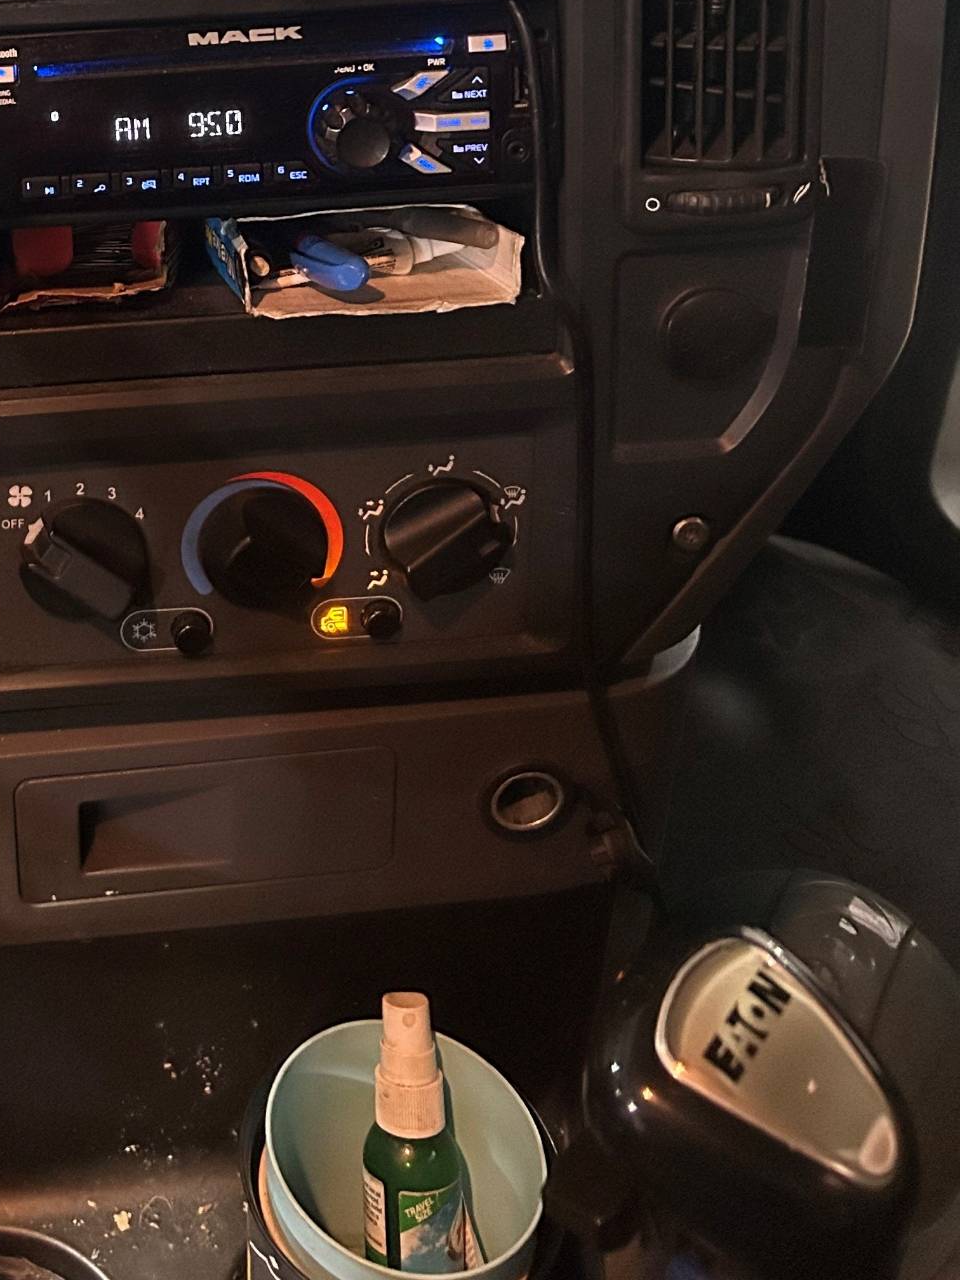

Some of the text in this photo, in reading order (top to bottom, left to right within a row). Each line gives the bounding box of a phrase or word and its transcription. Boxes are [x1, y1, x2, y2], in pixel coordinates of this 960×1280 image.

[187, 25, 303, 46] MACK
[427, 58, 445, 66] PWR
[464, 89, 487, 99] NEXT
[115, 109, 243, 141] AM 9:50
[464, 143, 488, 152] PREV
[177, 172, 210, 186] 4 RPT
[227, 169, 260, 183] 5 RDM
[277, 166, 308, 180] 6 ESC
[76, 179, 84, 188] 2
[126, 177, 133, 186] 3
[44, 482, 145, 520] 1 2 3 4
[1, 518, 25, 529] OFF
[702, 970, 791, 1085] EATON
[404, 1197, 434, 1218] TRAVEL
[415, 1208, 433, 1222] SIZE
